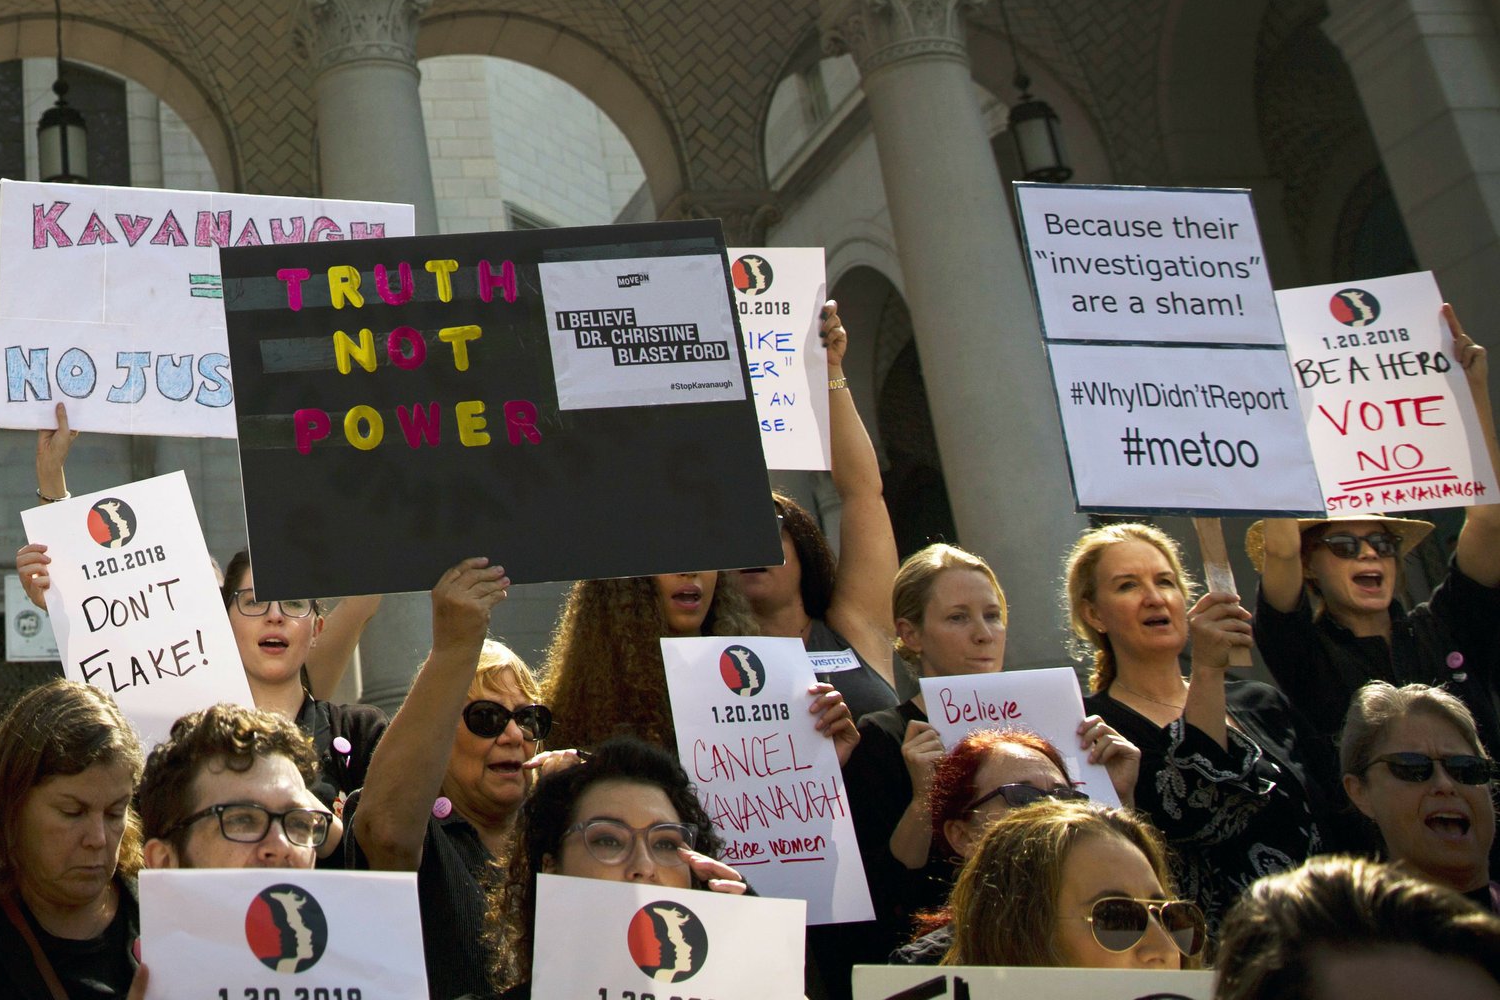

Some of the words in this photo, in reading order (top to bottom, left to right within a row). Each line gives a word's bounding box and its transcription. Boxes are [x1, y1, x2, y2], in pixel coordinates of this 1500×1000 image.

[1044, 213, 1163, 238] Because
[1172, 216, 1239, 240] their
[276, 258, 517, 312] TRUTH
[559, 312, 566, 329] I
[569, 309, 635, 328] BELIEVE
[1071, 293, 1118, 314] are
[1129, 295, 1145, 314] a
[1157, 292, 1245, 316] sham!
[333, 324, 483, 375] NOT
[579, 331, 608, 347] DR.
[611, 325, 697, 345] CHRISTINE
[745, 330, 796, 352] IKE
[1323, 328, 1410, 350] 1.20.2018
[617, 346, 679, 365] BLASEY
[683, 343, 726, 361] FORD
[1294, 357, 1341, 389] BE
[1347, 356, 1370, 385] A
[1376, 351, 1452, 381] HERO
[4, 345, 97, 403] NO
[670, 379, 733, 391] #StopKavanaugh
[770, 392, 796, 407] AN
[1070, 380, 1289, 416] #WhyIDidn'tReport
[293, 400, 542, 455] POWER
[1317, 395, 1447, 436] VOTE
[1120, 426, 1260, 468] #metoo
[1356, 443, 1424, 472] NO
[1326, 494, 1376, 512] STOP
[1381, 480, 1487, 503] KAVANAUGH
[81, 545, 166, 581] 1.20.2018
[81, 577, 181, 633] DON'T
[79, 629, 209, 693] FLAKE!
[811, 657, 852, 667] VISITOR
[712, 702, 790, 724] 1.20.2018
[939, 687, 1022, 724] Believe
[693, 733, 813, 783] CANCEL
